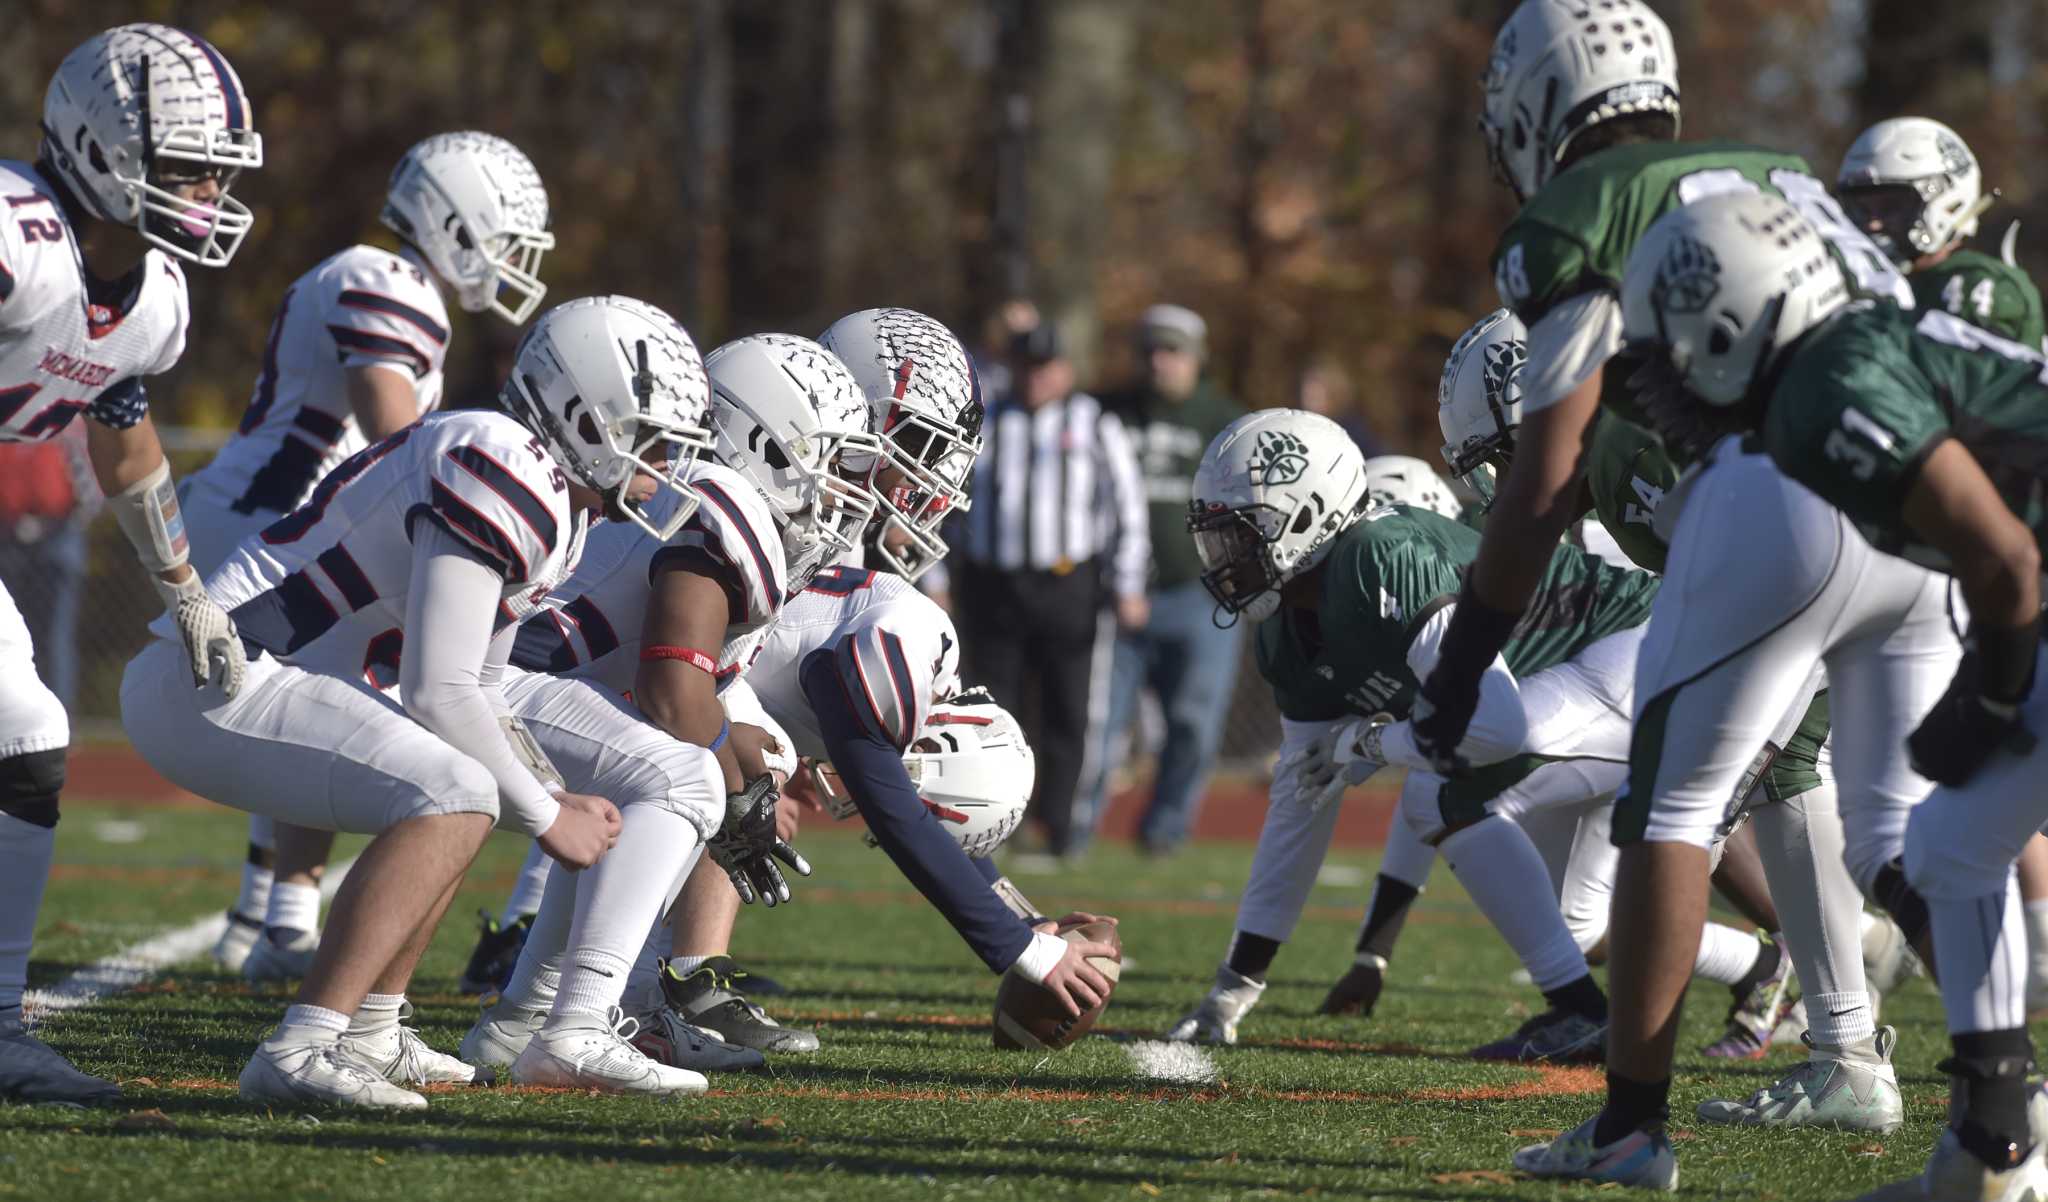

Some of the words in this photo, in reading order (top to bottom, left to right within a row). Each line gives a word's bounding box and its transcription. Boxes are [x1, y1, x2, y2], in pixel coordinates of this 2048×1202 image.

[7, 193, 64, 243] 12
[1941, 273, 1995, 317] 44
[1825, 406, 1897, 482] 31
